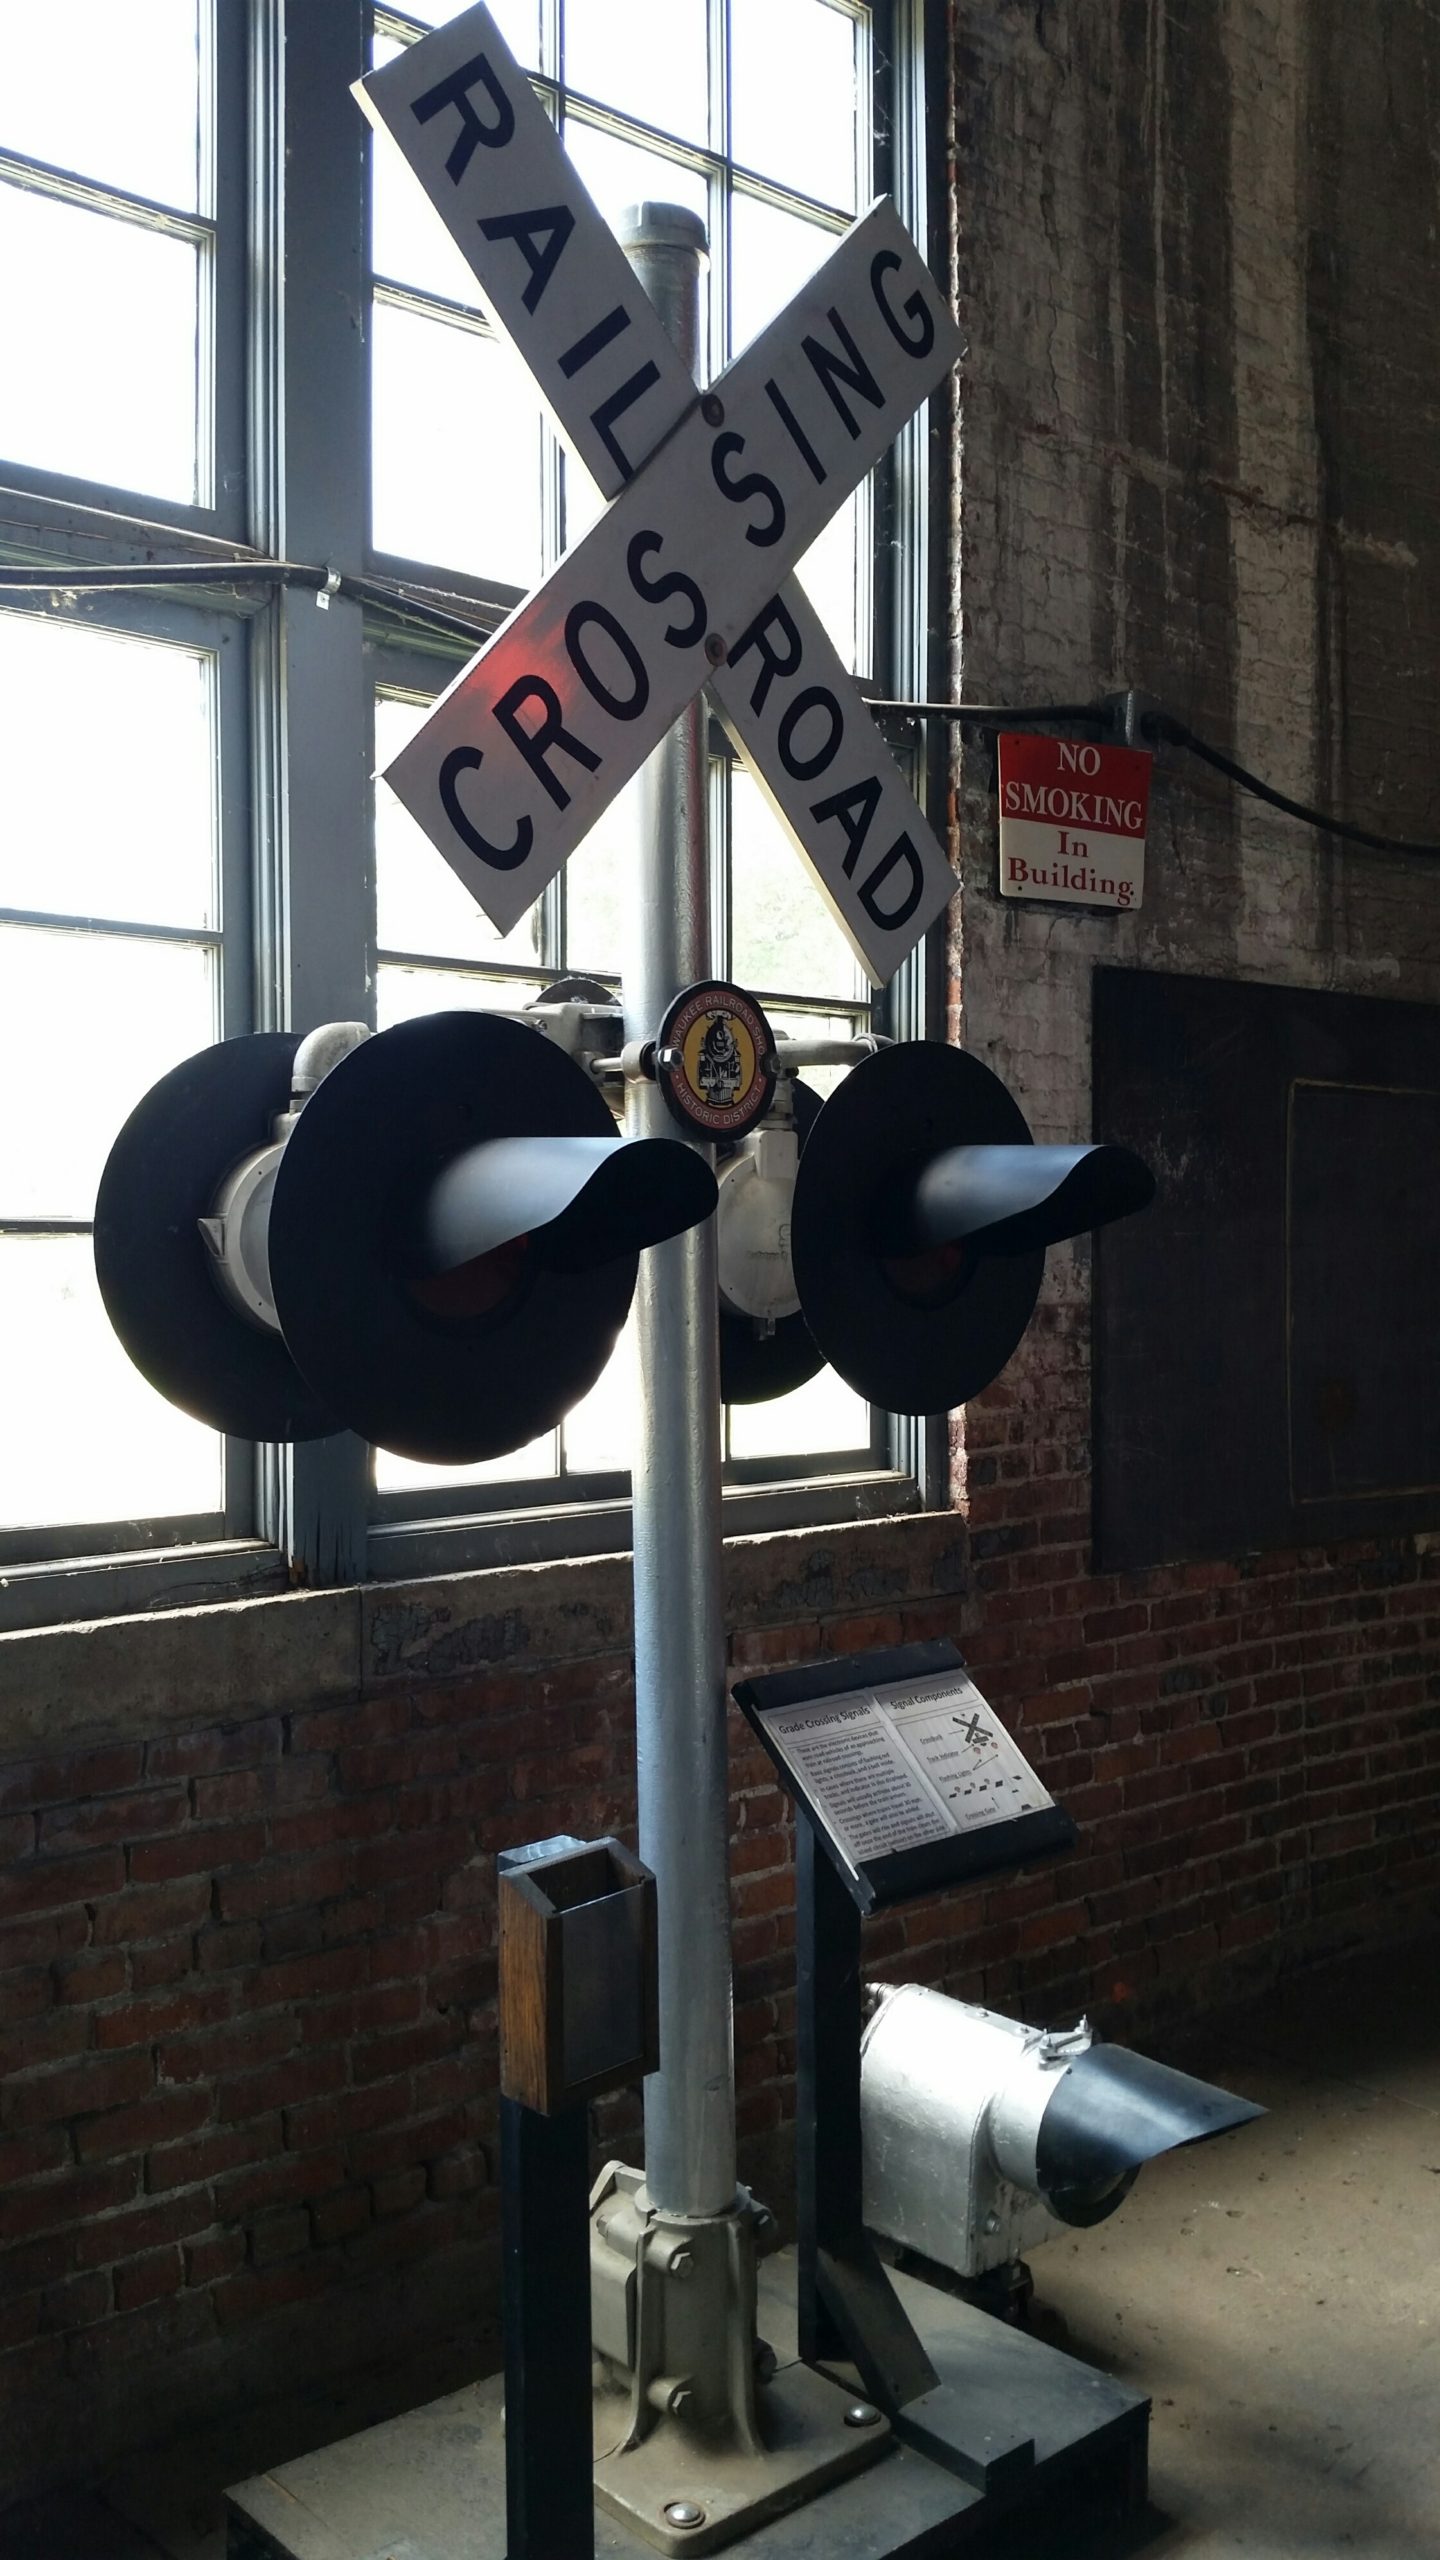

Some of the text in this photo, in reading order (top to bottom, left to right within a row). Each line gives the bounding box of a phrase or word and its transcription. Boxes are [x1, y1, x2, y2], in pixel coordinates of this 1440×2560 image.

[410, 52, 661, 482] RAIL
[438, 250, 935, 871] CROSSING
[727, 594, 924, 931] ROAD
[1057, 742, 1100, 776] NO
[1005, 781, 1143, 830] SMOKING
[1057, 831, 1089, 858] In
[1007, 857, 1134, 906] Building
[705, 996, 754, 1026] RAILROAD
[676, 1082, 762, 1125] HISTORIC DISTRICT
[778, 1705, 871, 1735] Grade Crossing Signals
[890, 1686, 963, 1711] Signal Components
